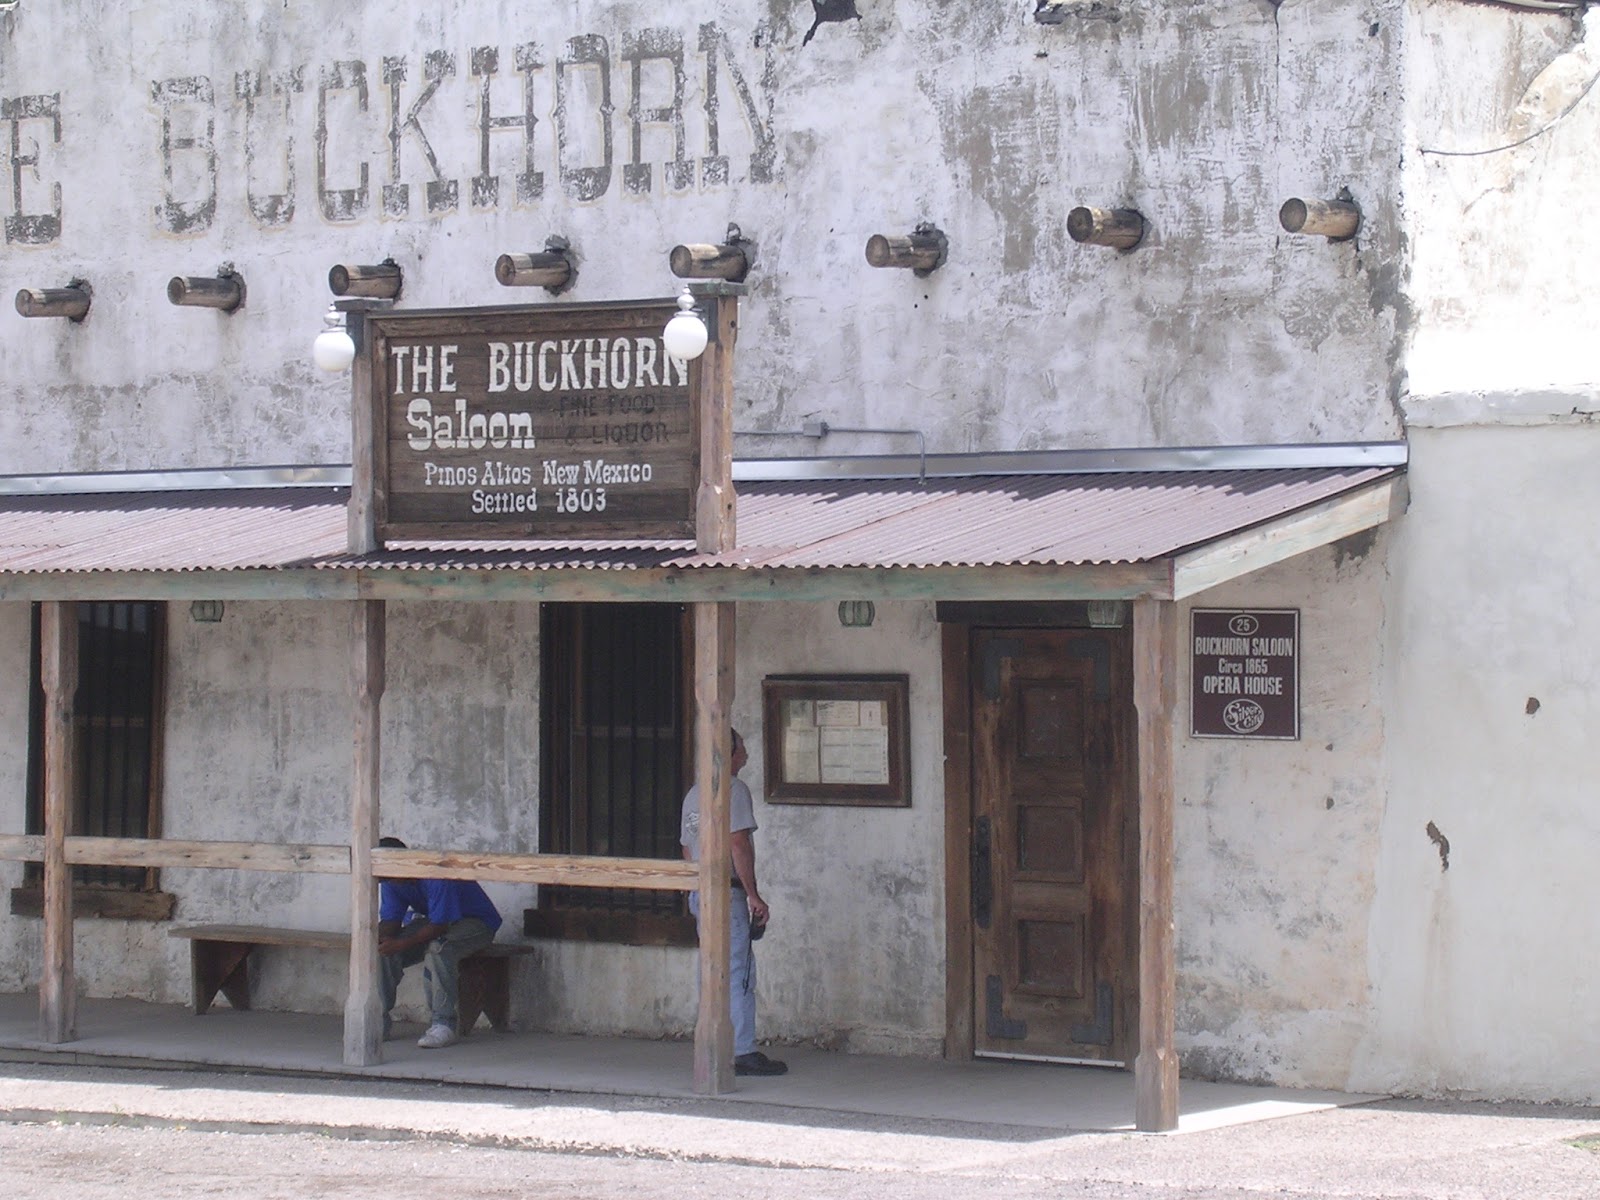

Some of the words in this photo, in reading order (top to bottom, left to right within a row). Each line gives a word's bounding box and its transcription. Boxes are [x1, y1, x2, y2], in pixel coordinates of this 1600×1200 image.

[151, 21, 780, 236] BUCKHORN
[391, 345, 458, 394] THE
[487, 336, 689, 393] BUCKHORN
[608, 394, 656, 415] FOOD
[406, 398, 535, 451] Saloon
[424, 462, 477, 486] Pinos
[481, 461, 531, 486] Altos
[543, 460, 579, 485] New
[584, 459, 652, 484] Mexico
[472, 487, 538, 513] Settled
[555, 488, 607, 513] 1803
[1236, 618, 1251, 632] 25
[1195, 636, 1250, 656] BUCKHORN
[1251, 637, 1293, 657] SALOON
[1218, 657, 1243, 674] Circa
[1245, 658, 1269, 675] 1865
[1203, 675, 1241, 695] OPERA
[1244, 676, 1283, 695] HOUSE
